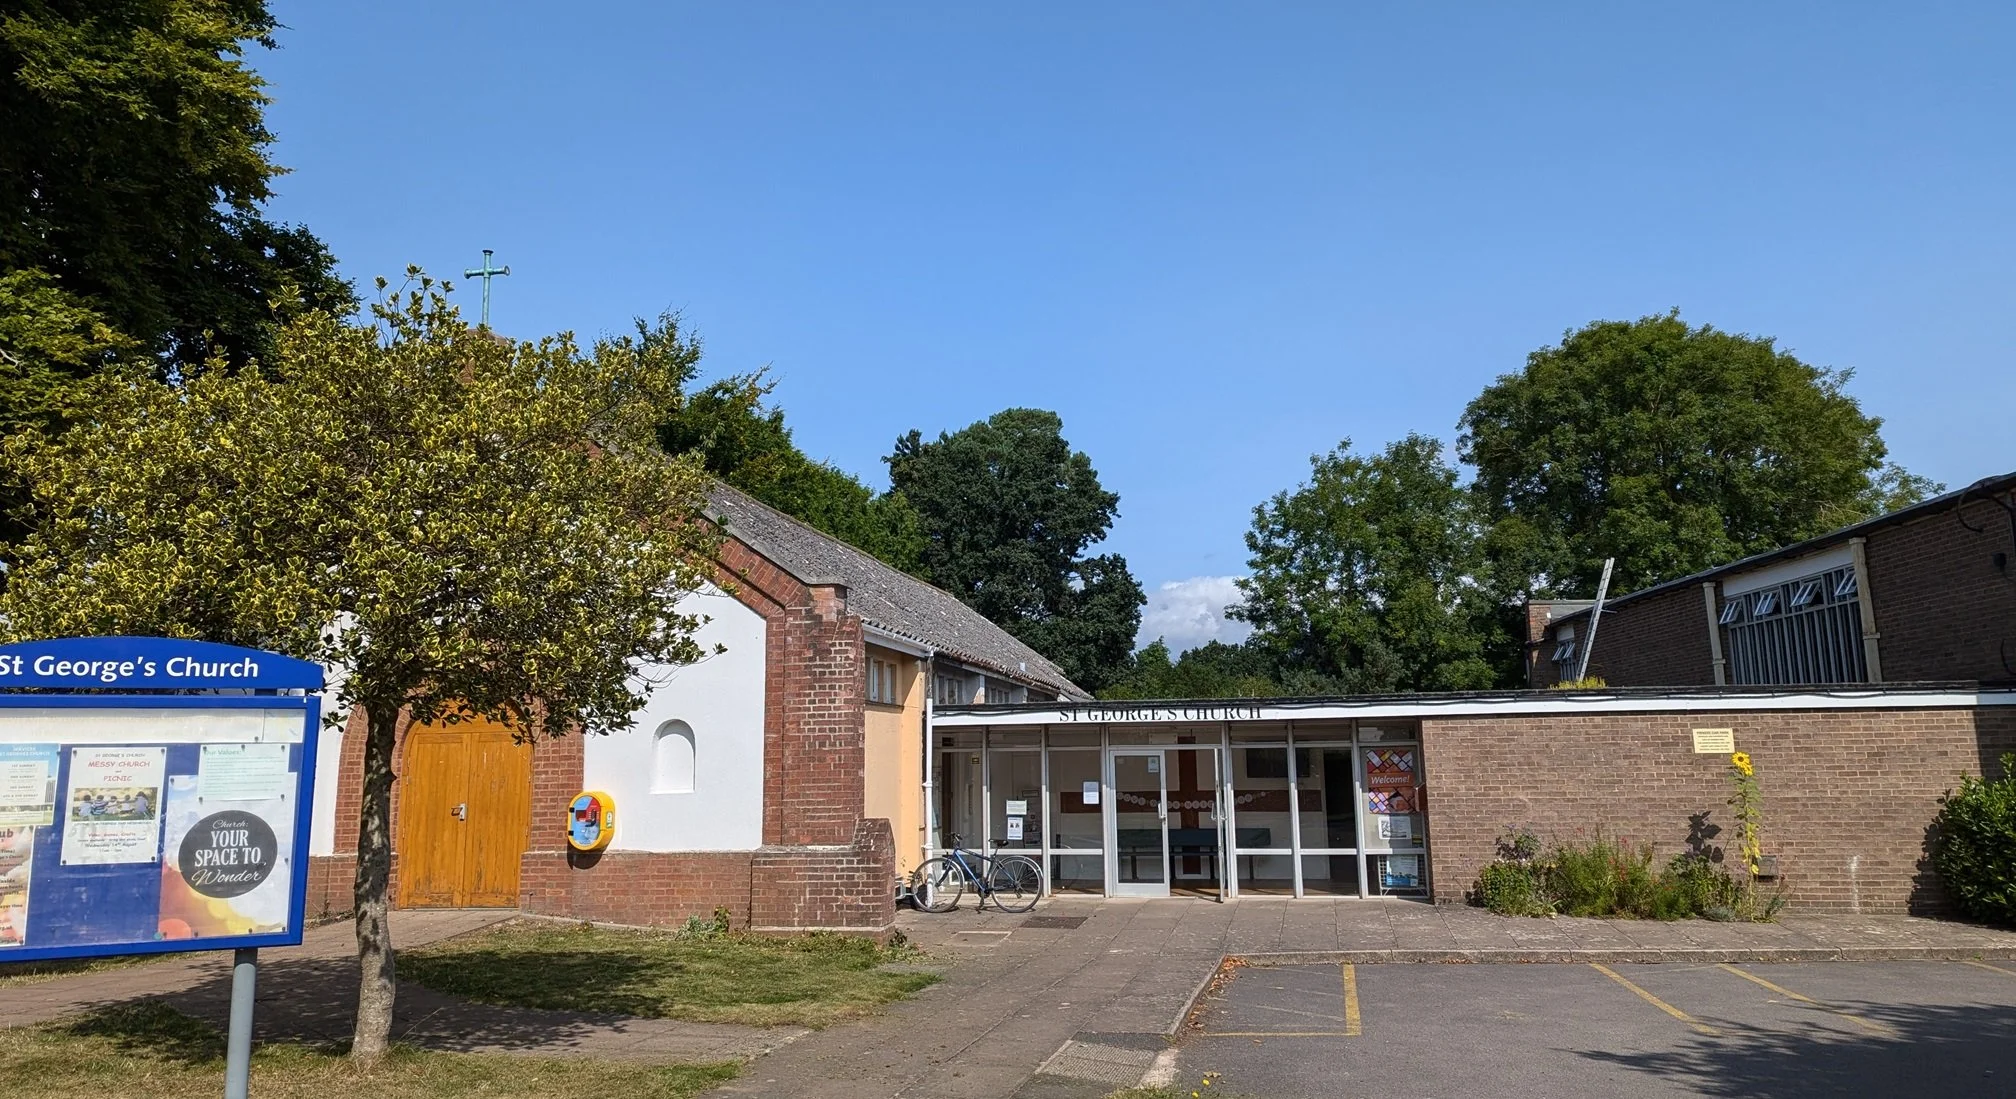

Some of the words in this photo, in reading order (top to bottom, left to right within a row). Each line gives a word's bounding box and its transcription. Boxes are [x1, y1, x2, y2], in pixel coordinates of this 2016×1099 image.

[0, 655, 24, 676] St
[33, 655, 156, 682] George's
[166, 656, 259, 678] Church
[1087, 706, 1177, 722] GEORGES
[1183, 705, 1262, 721] CHURCH
[1371, 775, 1410, 784] Welcome!
[210, 829, 249, 848] YOUR
[194, 848, 239, 867] SPACE
[242, 847, 262, 865] TO
[191, 868, 263, 887] Wonder
